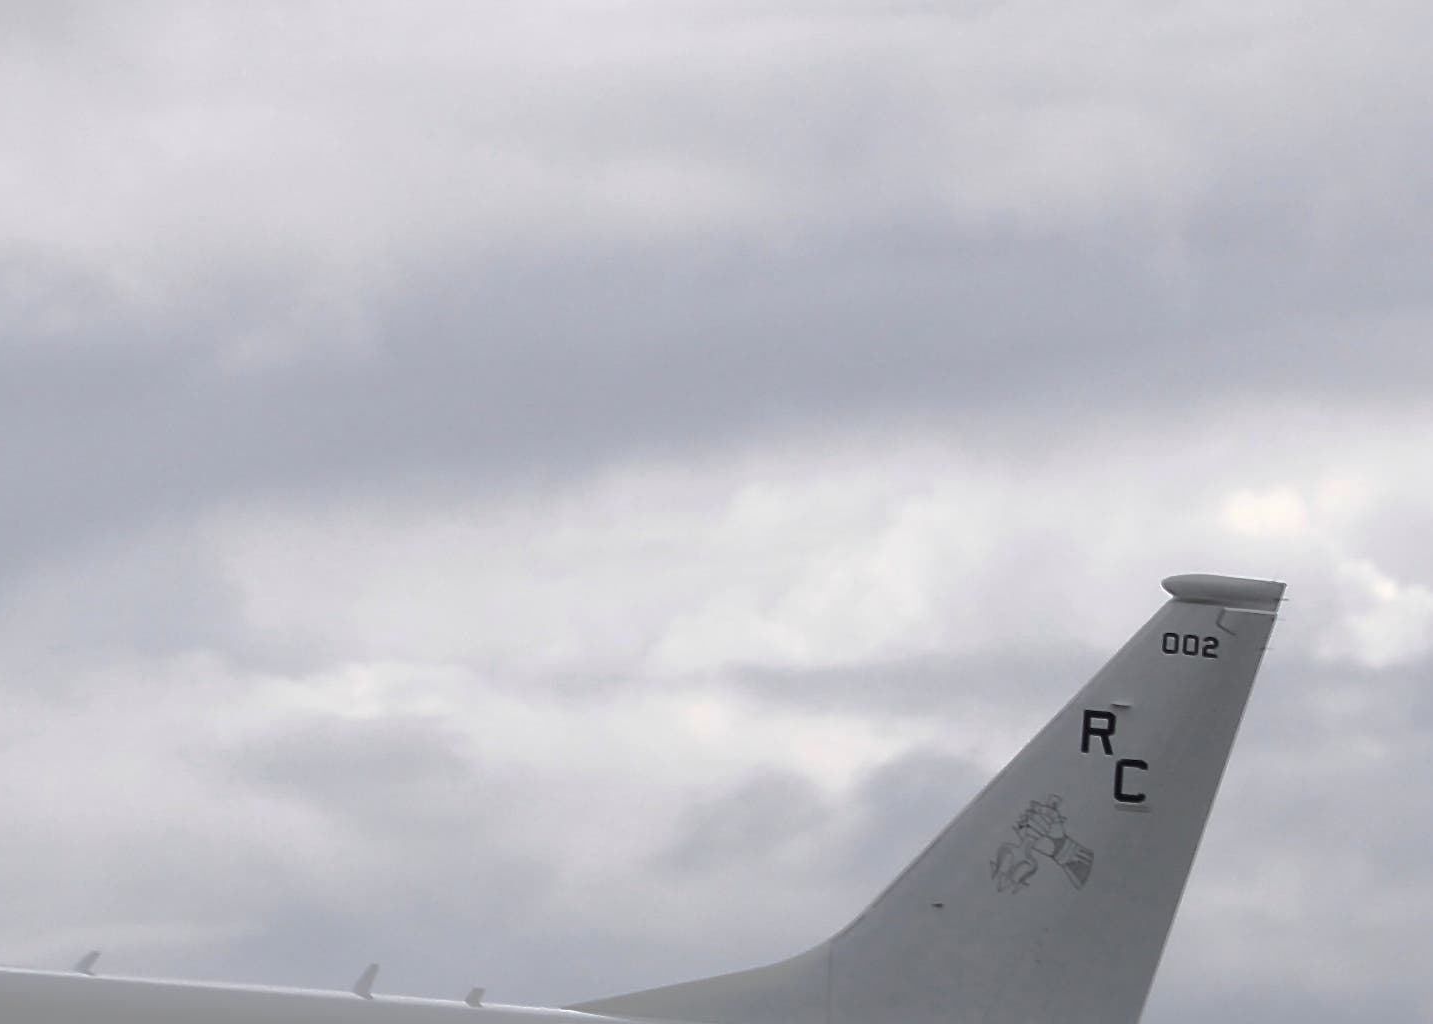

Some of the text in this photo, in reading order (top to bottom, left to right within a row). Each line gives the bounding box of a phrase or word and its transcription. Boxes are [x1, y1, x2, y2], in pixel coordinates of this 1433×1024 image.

[1161, 632, 1219, 659] 002
[1080, 709, 1116, 756] R
[1114, 759, 1149, 804] C
